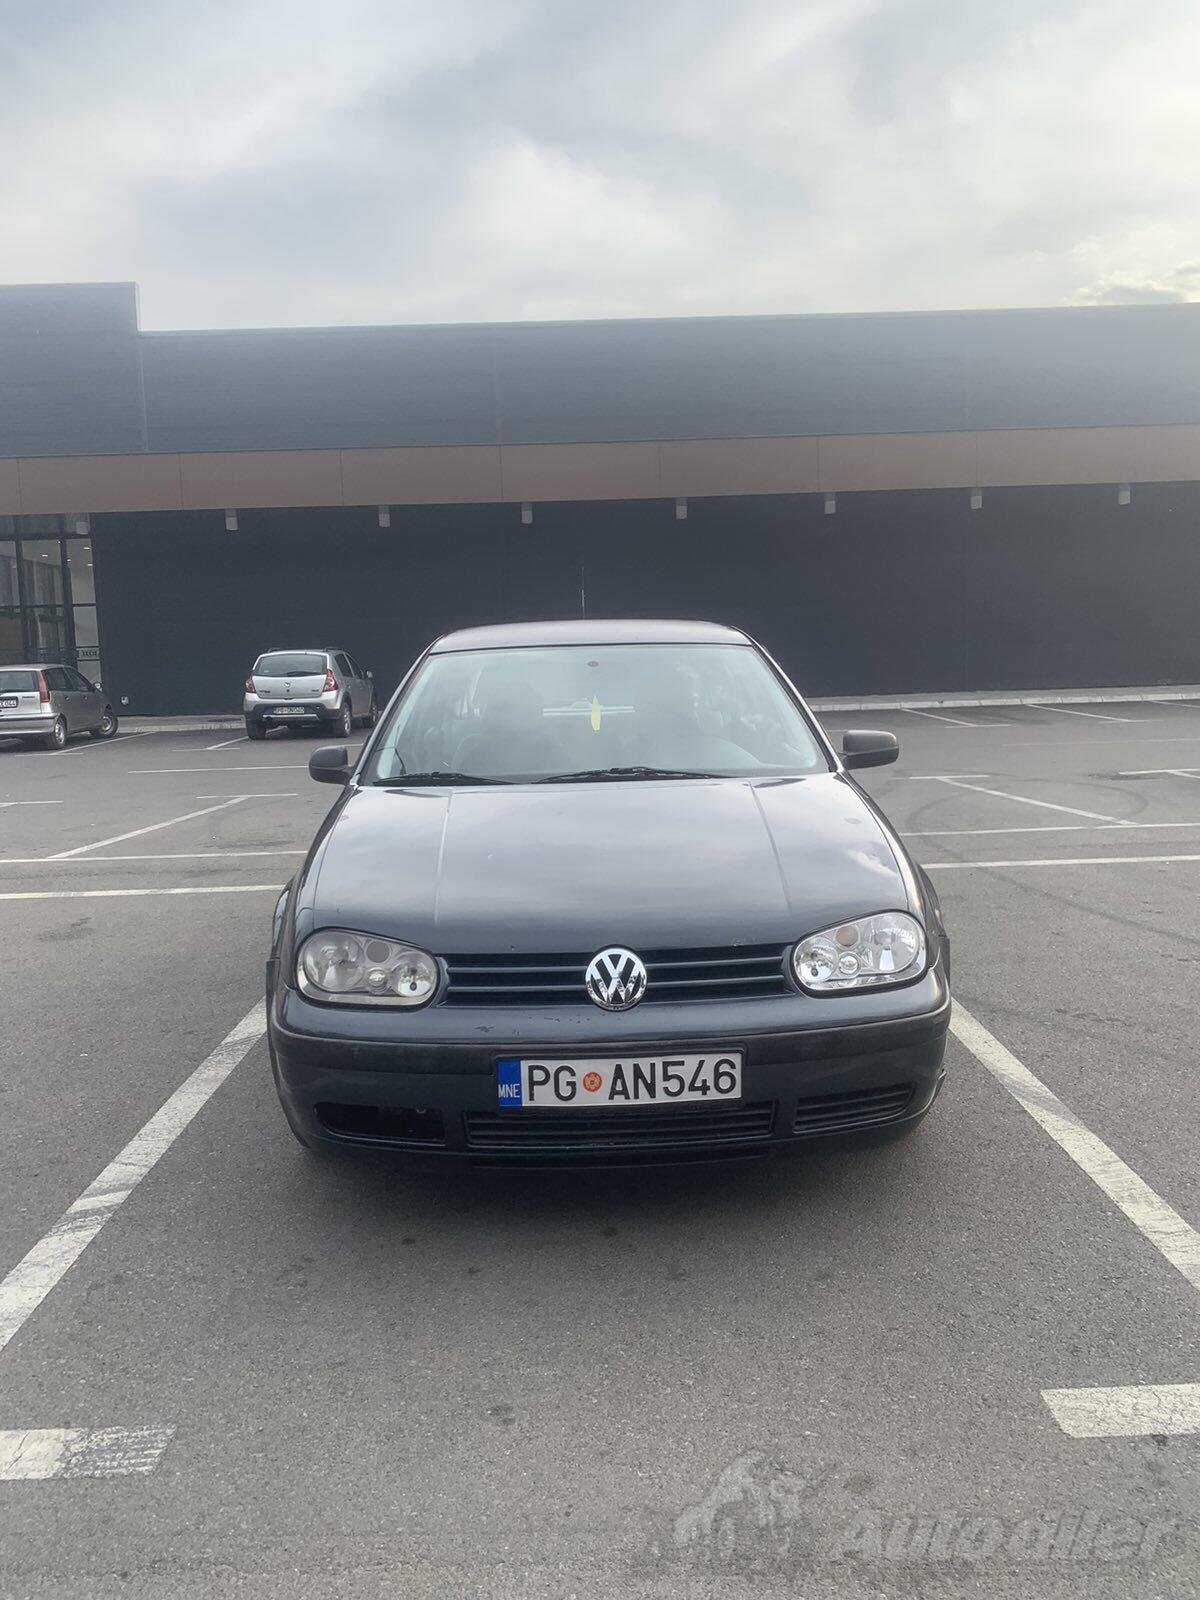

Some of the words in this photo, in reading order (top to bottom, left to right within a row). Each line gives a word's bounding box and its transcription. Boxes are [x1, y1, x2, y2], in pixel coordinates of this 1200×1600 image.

[586, 948, 647, 1010] VW
[498, 1083, 521, 1098] MNE
[527, 1064, 577, 1102] PG
[608, 1058, 738, 1101] AN546
